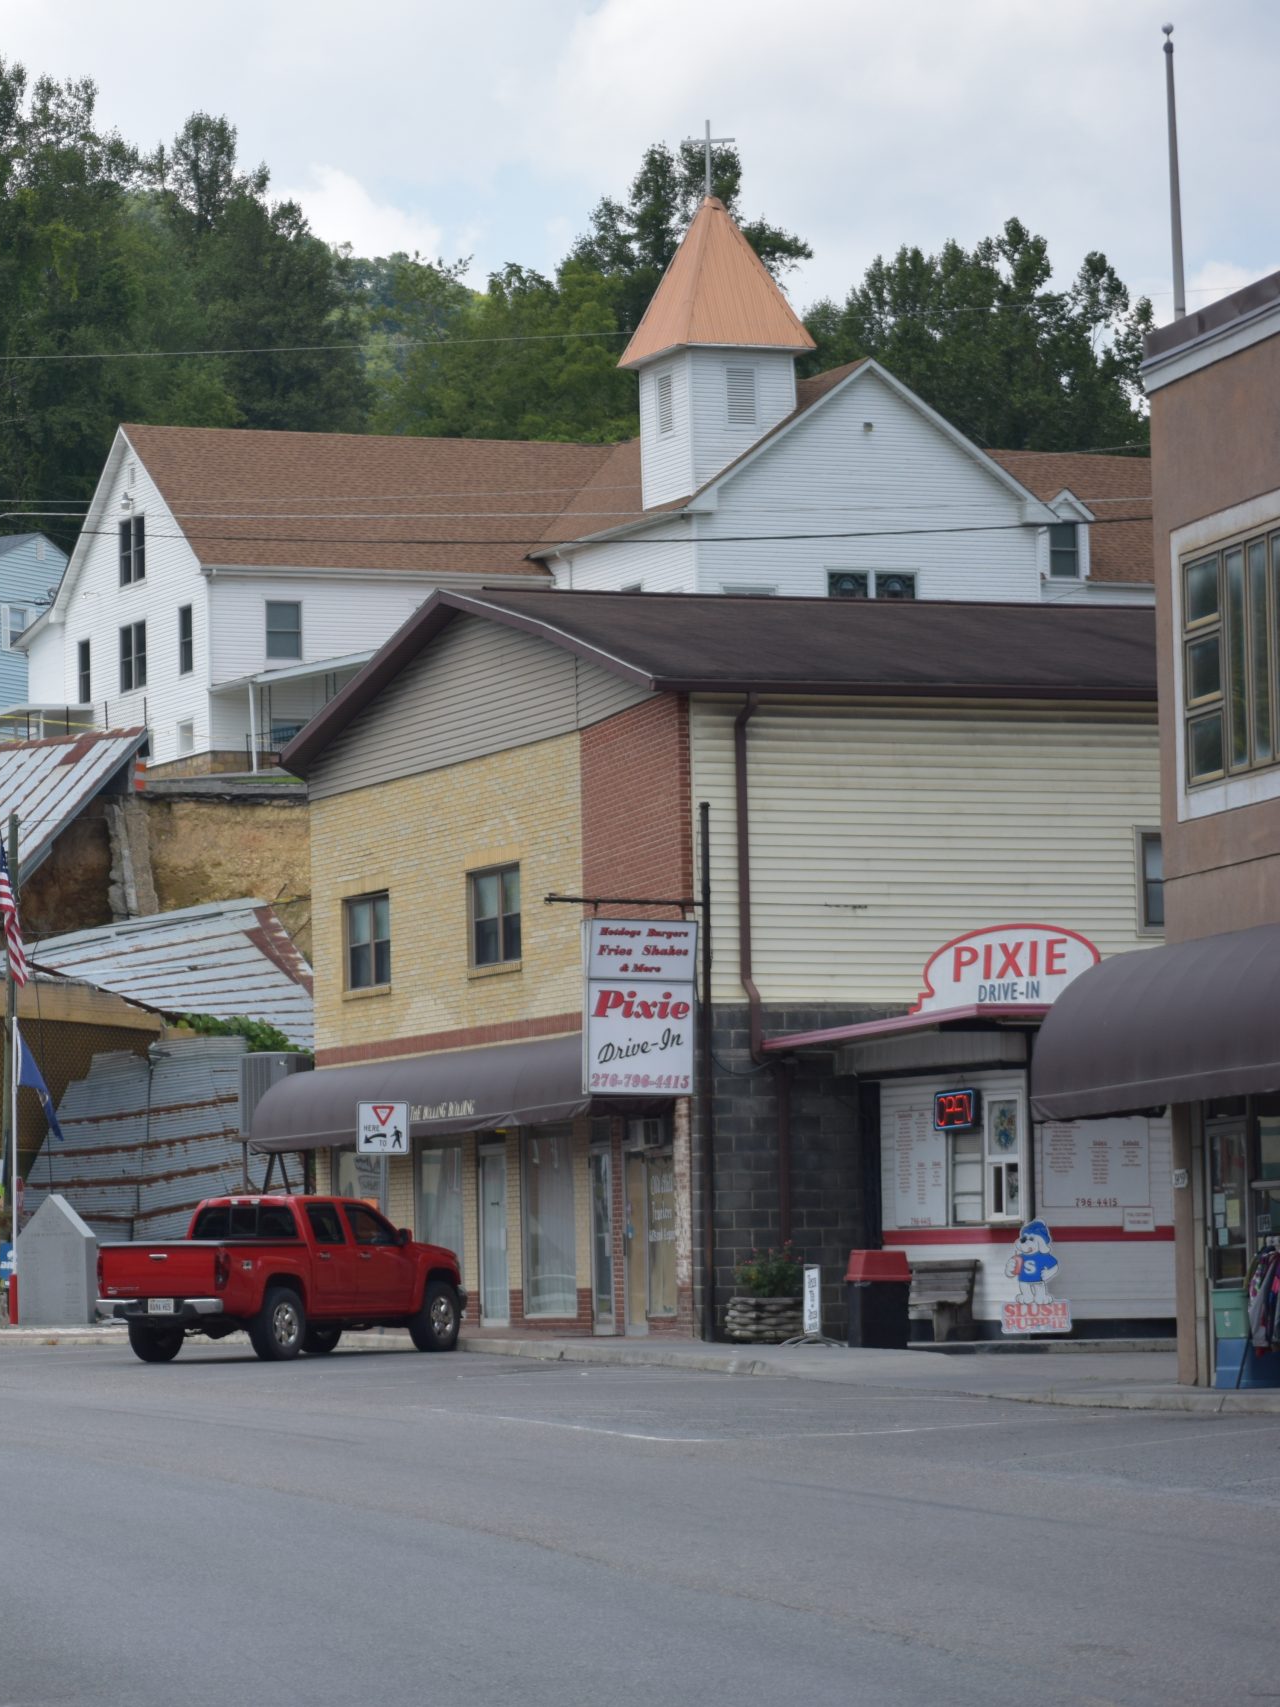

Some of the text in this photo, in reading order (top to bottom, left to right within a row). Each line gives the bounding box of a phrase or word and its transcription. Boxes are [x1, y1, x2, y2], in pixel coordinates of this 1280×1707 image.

[599, 926, 689, 939] Hotdogs Burgers
[597, 944, 689, 956] Fries Shakes
[952, 937, 1068, 983] PIXIE
[631, 963, 661, 973] More
[977, 980, 1041, 1003] DRIVE-IN
[591, 989, 690, 1020] Pixie
[597, 1027, 684, 1064] Drive-In
[591, 1072, 690, 1089] 276-796-4415
[363, 1124, 380, 1132] HERE
[379, 1139, 387, 1147] TO
[1023, 1259, 1037, 1274] S
[1004, 1302, 1067, 1316] SLUSH
